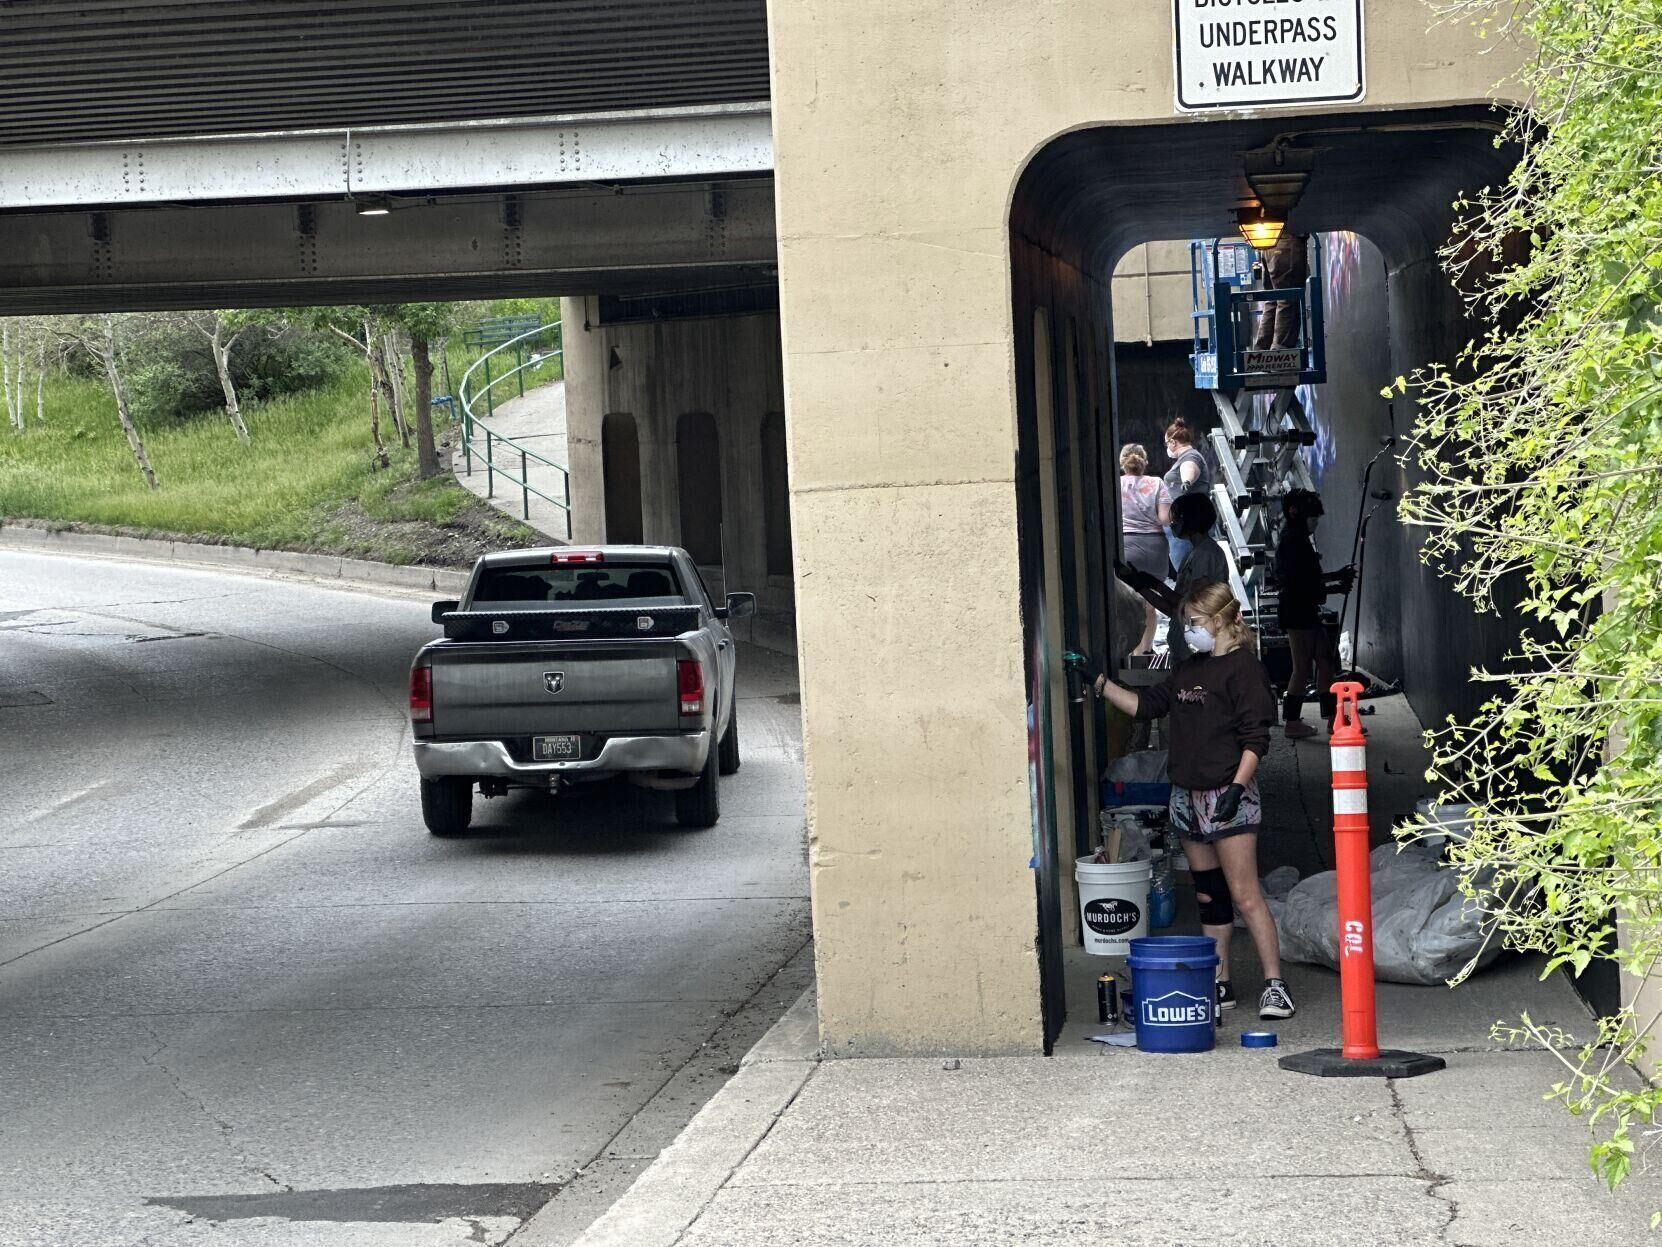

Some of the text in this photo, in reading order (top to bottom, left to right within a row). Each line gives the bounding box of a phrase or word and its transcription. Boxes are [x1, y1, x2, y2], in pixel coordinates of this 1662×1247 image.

[1199, 15, 1337, 48] UNDERPASS
[1213, 56, 1325, 87] WALKWAY
[1246, 352, 1298, 364] MIDWAY
[1264, 361, 1297, 370] RENTAL
[542, 742, 572, 754] DAY553
[1086, 912, 1137, 923] MURDOCH'S
[1148, 1003, 1206, 1022] LOWE'S
